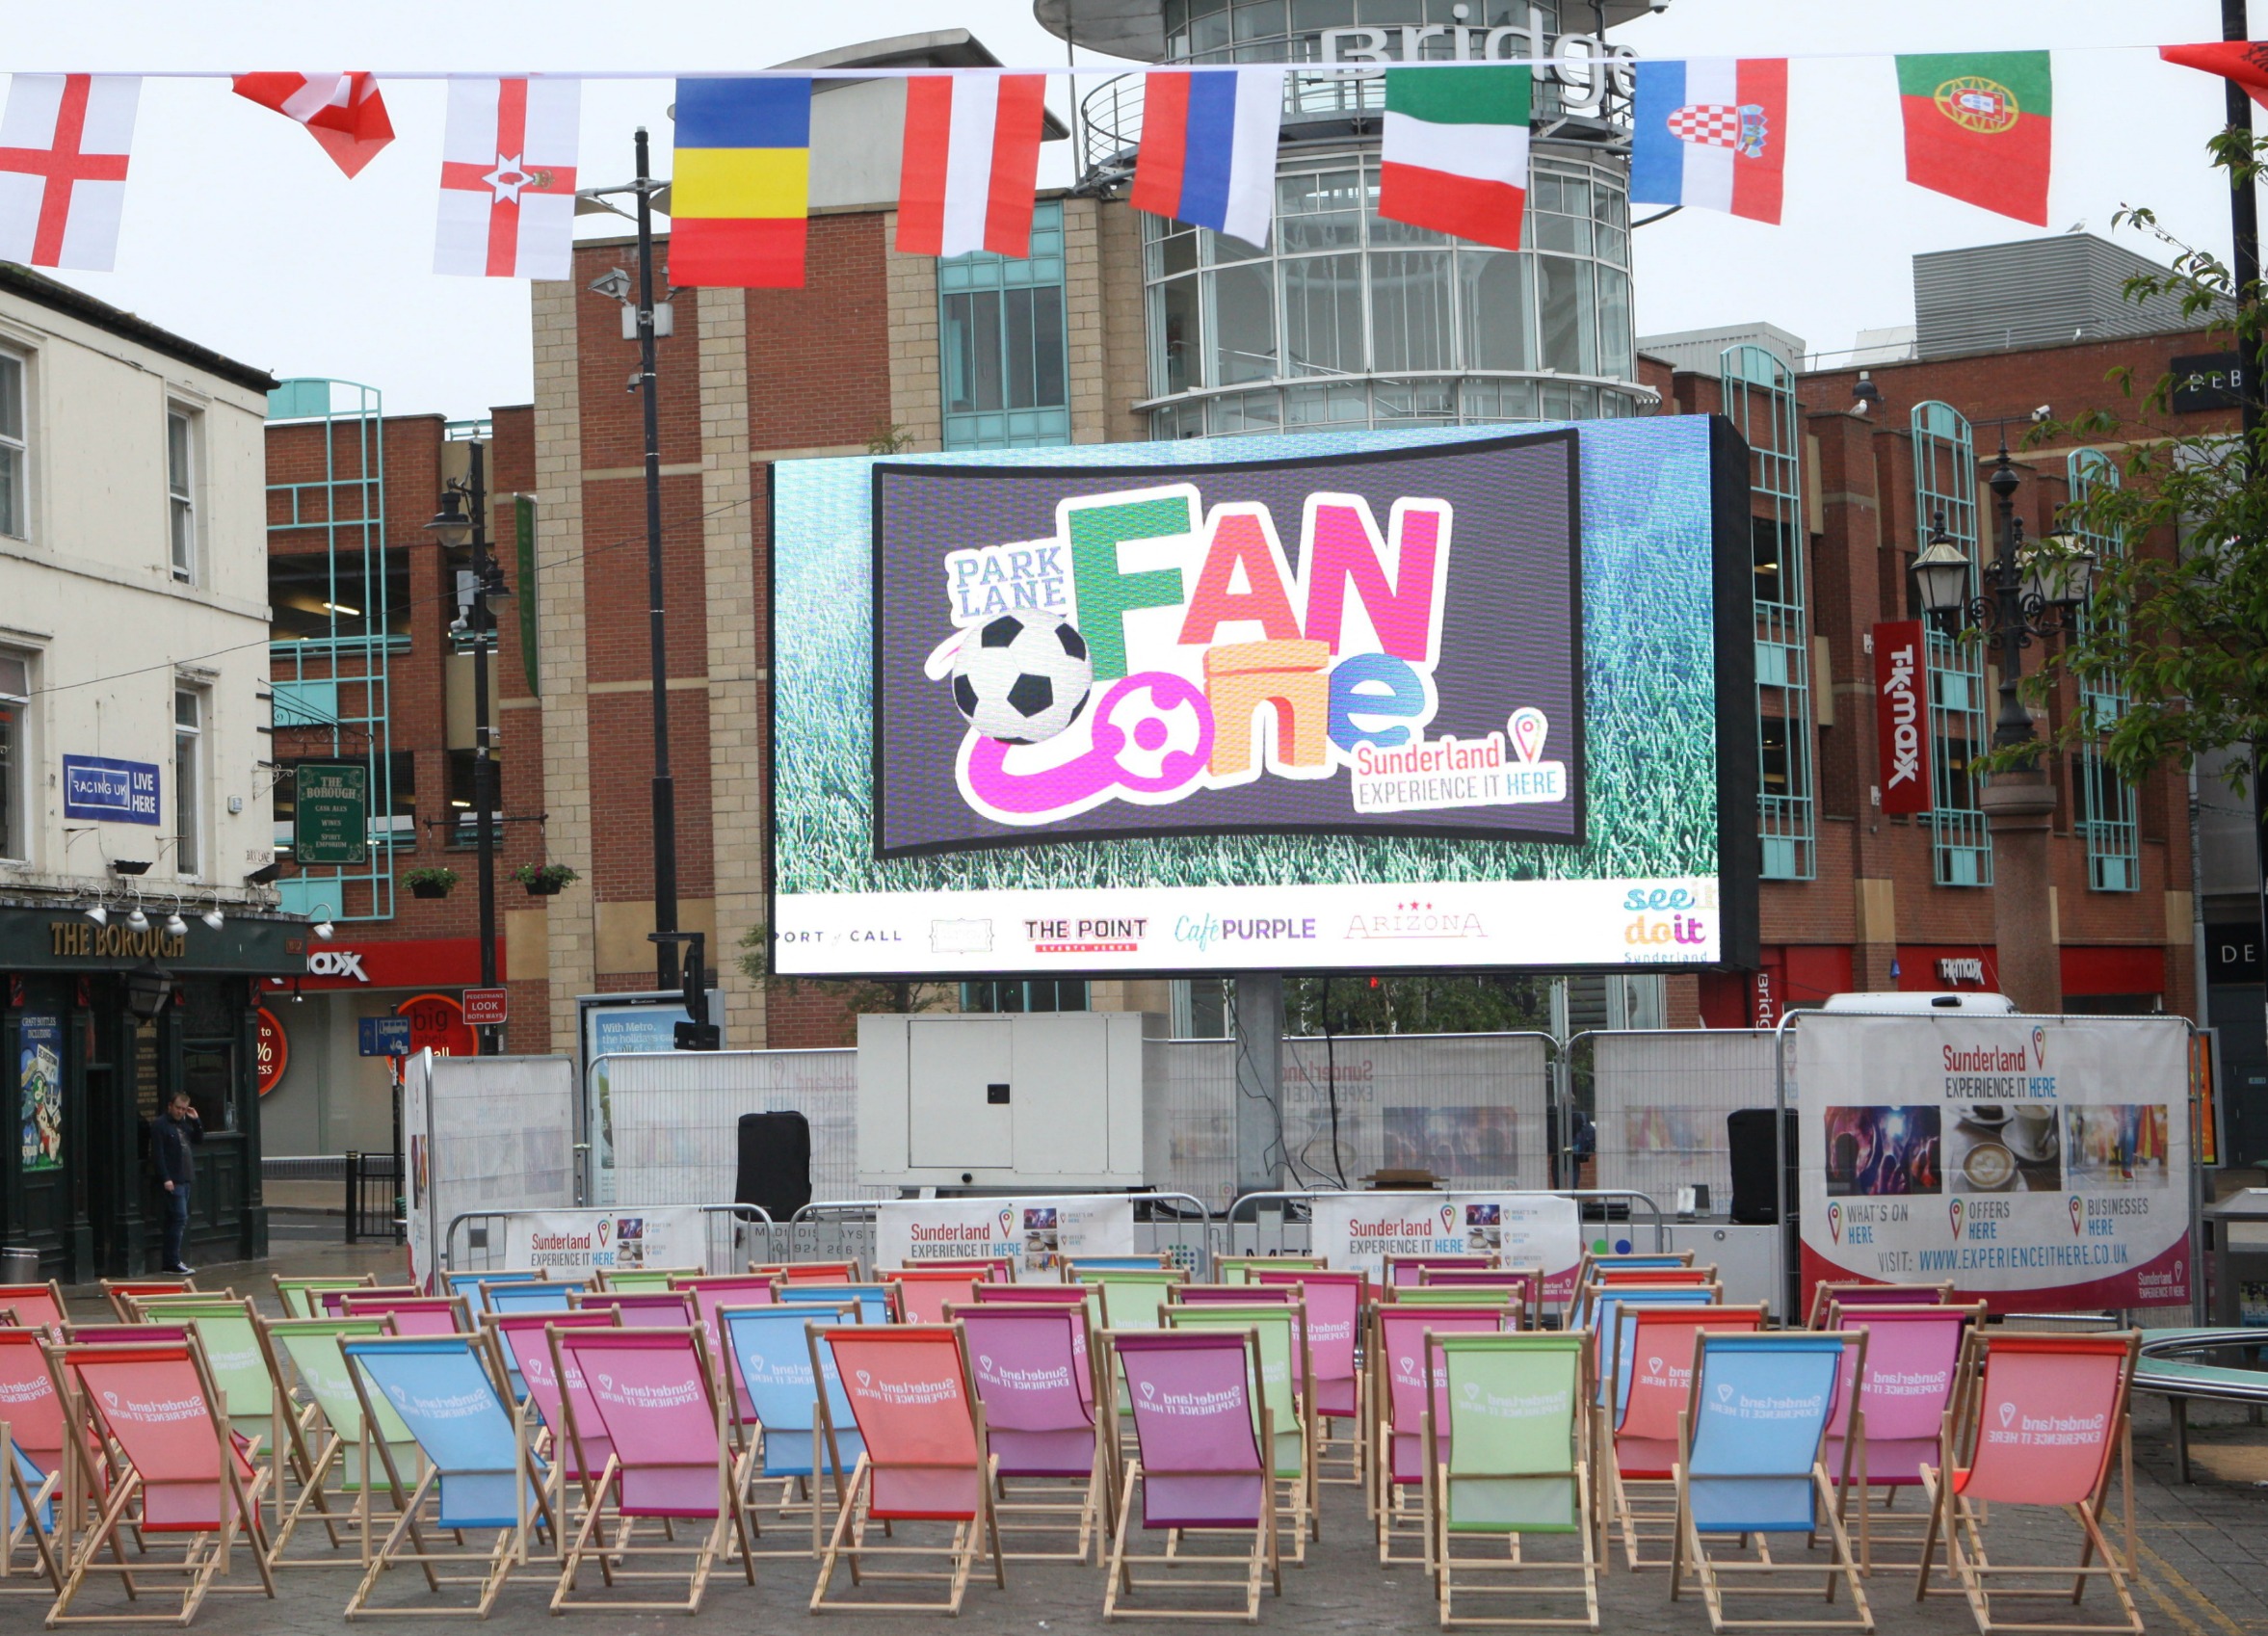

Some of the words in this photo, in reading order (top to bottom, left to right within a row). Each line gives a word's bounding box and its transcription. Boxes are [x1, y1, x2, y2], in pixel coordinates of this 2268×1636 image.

[955, 546, 1064, 588] PARK
[958, 576, 1067, 618] LANE
[1068, 495, 1439, 682] FAN
[1358, 739, 1499, 776] Sunderland
[73, 779, 112, 795] RACING
[114, 783, 127, 796] UK
[133, 772, 154, 791] LIVE
[321, 777, 343, 787] THE
[1359, 777, 1478, 805] EXPERIENCE
[1485, 775, 1500, 798] IT
[1507, 771, 1557, 796] HERE
[306, 787, 356, 799] BOROUGH
[132, 794, 155, 813] HERE
[1623, 888, 1696, 910] see
[1025, 921, 1068, 938] THE
[1078, 919, 1147, 938] POINT
[1174, 912, 1220, 952] Café
[1223, 918, 1316, 940] PURPLE
[1343, 913, 1488, 939] ARIZONA
[51, 921, 90, 956] THE
[96, 925, 185, 957] BOROUGH
[850, 930, 903, 942] CALL
[472, 1002, 498, 1011] LOOK
[414, 1008, 448, 1032] big
[602, 1023, 623, 1033] With
[602, 1035, 618, 1043] the
[1942, 1044, 2026, 1071] Sunderland
[1945, 1077, 2015, 1097] EXPERIENCE
[2017, 1077, 2026, 1097] IT
[2029, 1077, 2057, 1097] HERE
[1847, 1204, 1887, 1223] WHAT'S
[1891, 1204, 1909, 1222] ON
[1968, 1201, 2010, 1219] OFFERS
[2088, 1198, 2149, 1216] BUSINESSES
[910, 1224, 990, 1240] Sunderland
[1350, 1219, 1432, 1236] Sunderland
[1848, 1227, 1873, 1244] HERE
[1968, 1222, 1996, 1240] HERE
[2089, 1219, 2114, 1236] HERE
[532, 1233, 591, 1251] Sunderland
[911, 1244, 977, 1258] EXPERIENCE
[981, 1244, 990, 1257] IT
[993, 1242, 1022, 1256] HERE
[1350, 1239, 1419, 1253] EXPERIENCE
[1422, 1240, 1432, 1253] IT
[1435, 1239, 1464, 1253] HERE
[531, 1253, 580, 1266] EXPERIENCE
[582, 1253, 591, 1265] IT
[592, 1253, 615, 1265] HERE
[1878, 1252, 1912, 1272] VISIT:
[1919, 1244, 2128, 1271] WWW.EXPERIENCEITHERE.CO.UK
[2138, 1272, 2173, 1285] Sunderland
[2139, 1285, 2168, 1299] EXPERIENCE
